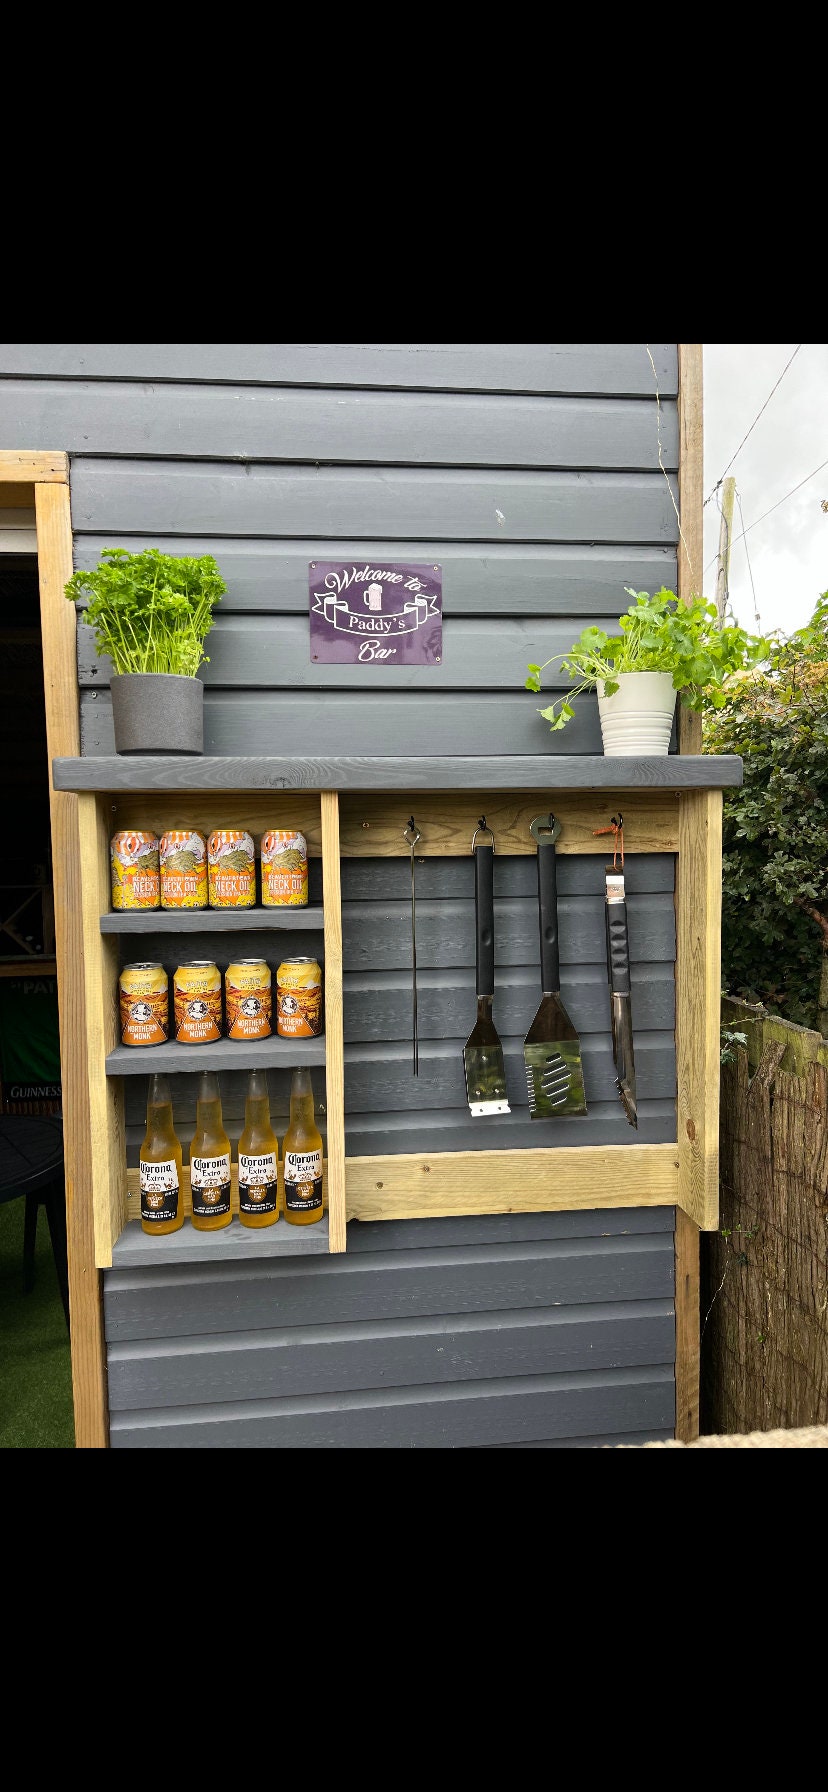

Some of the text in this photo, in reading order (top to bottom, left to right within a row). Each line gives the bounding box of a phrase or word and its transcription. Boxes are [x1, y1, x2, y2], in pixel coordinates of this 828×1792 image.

[325, 566, 427, 593] Welcome to
[349, 616, 406, 634] Paddy's
[358, 640, 397, 662] Bar
[133, 881, 154, 892] NECK
[163, 881, 183, 892] NECK
[184, 881, 198, 892] OIL
[216, 880, 251, 891] NECK OIL
[268, 879, 303, 890] NECK OIL
[128, 1023, 158, 1034] NORTHERN
[184, 1021, 213, 1031] NORTHERN
[238, 1018, 265, 1028] NORTHERN
[189, 1029, 207, 1038] MONK
[243, 1026, 260, 1034] MONK
[133, 1032, 151, 1040] MONK
[10, 1085, 62, 1099] GUINNESS
[193, 1158, 228, 1172] Corona
[240, 1156, 274, 1167] Corona
[288, 1153, 321, 1166] Corona
[140, 1161, 173, 1174] Corona
[202, 1169, 221, 1177] Extra
[248, 1166, 267, 1174] Extra
[297, 1164, 315, 1172] Extra
[146, 1173, 165, 1182] Extra
